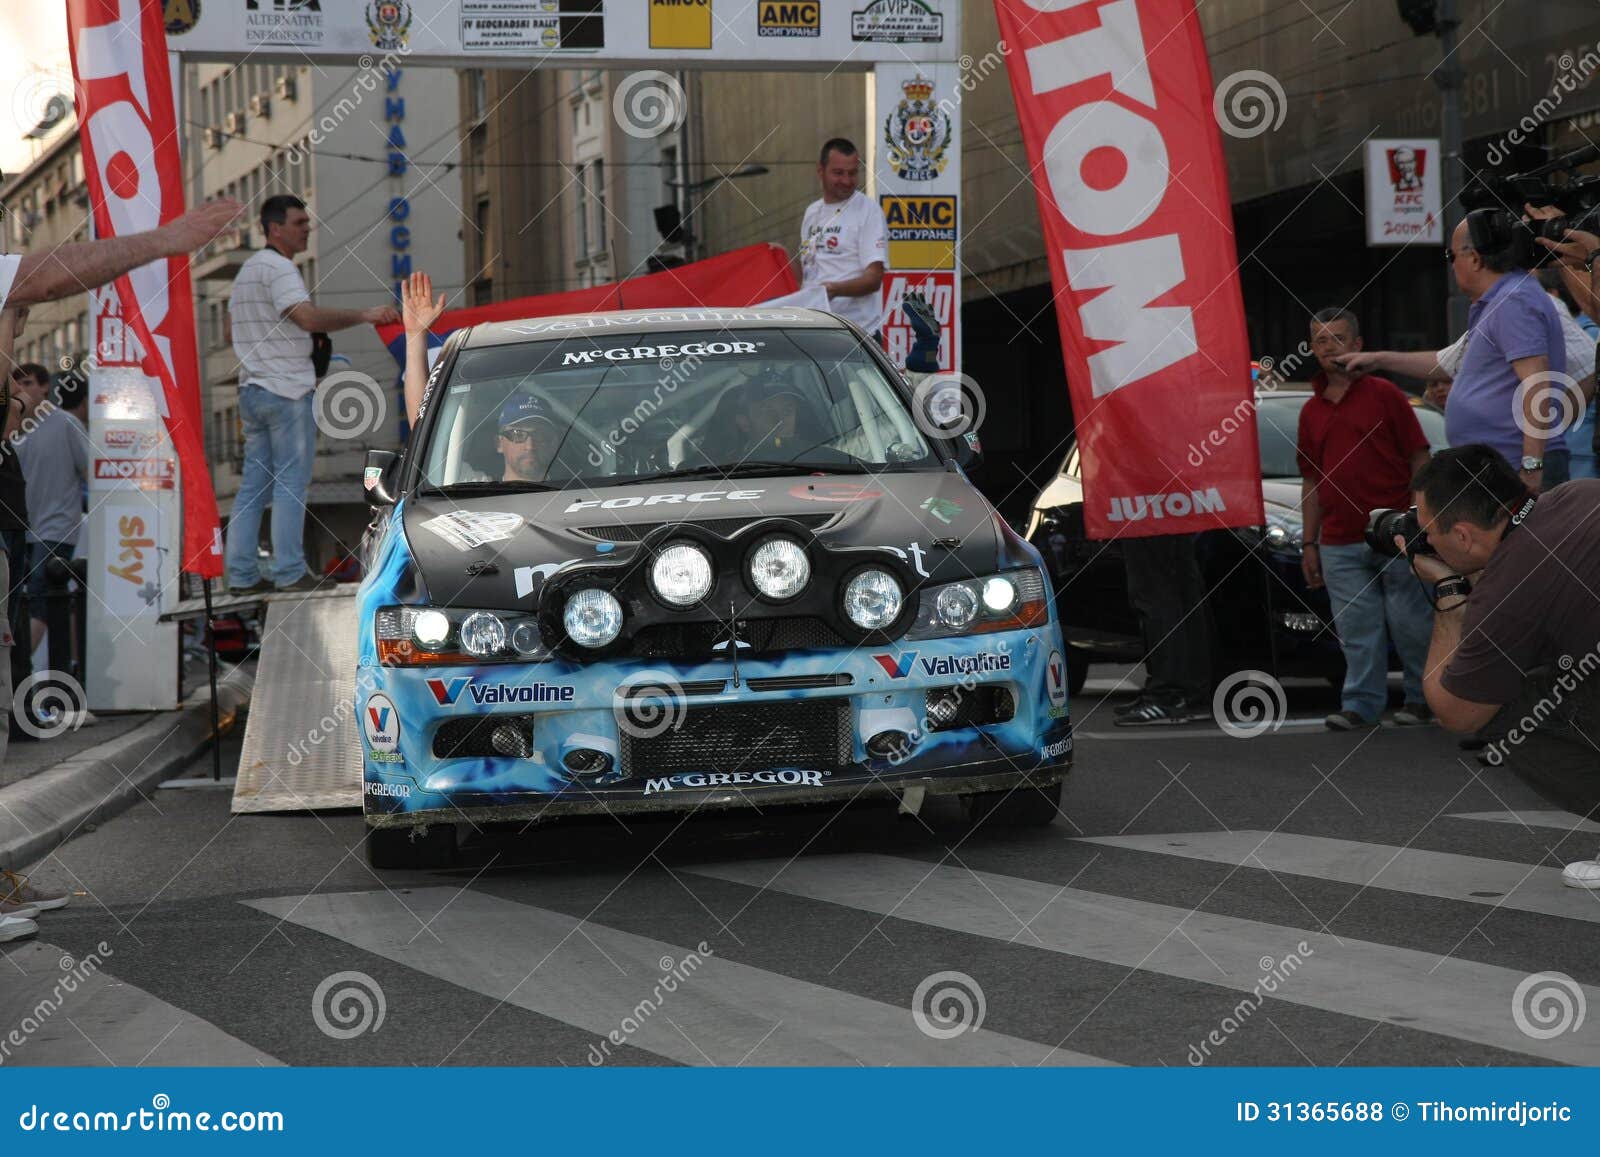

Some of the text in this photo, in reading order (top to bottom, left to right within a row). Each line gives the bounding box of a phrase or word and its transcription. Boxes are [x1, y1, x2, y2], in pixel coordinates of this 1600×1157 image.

[247, 15, 323, 26] ALTERNATIVE
[476, 20, 529, 29] BEOGRADSKI
[533, 19, 558, 28] RALLY
[246, 30, 324, 42] ENERGIES CUP
[1394, 194, 1424, 205] KFC
[1383, 221, 1422, 236] 200m
[98, 460, 169, 478] MOTUL
[564, 489, 766, 514] FORCE
[1511, 497, 1537, 525] Canon
[920, 652, 1011, 677] Valvoline
[469, 682, 575, 704] Valvoline
